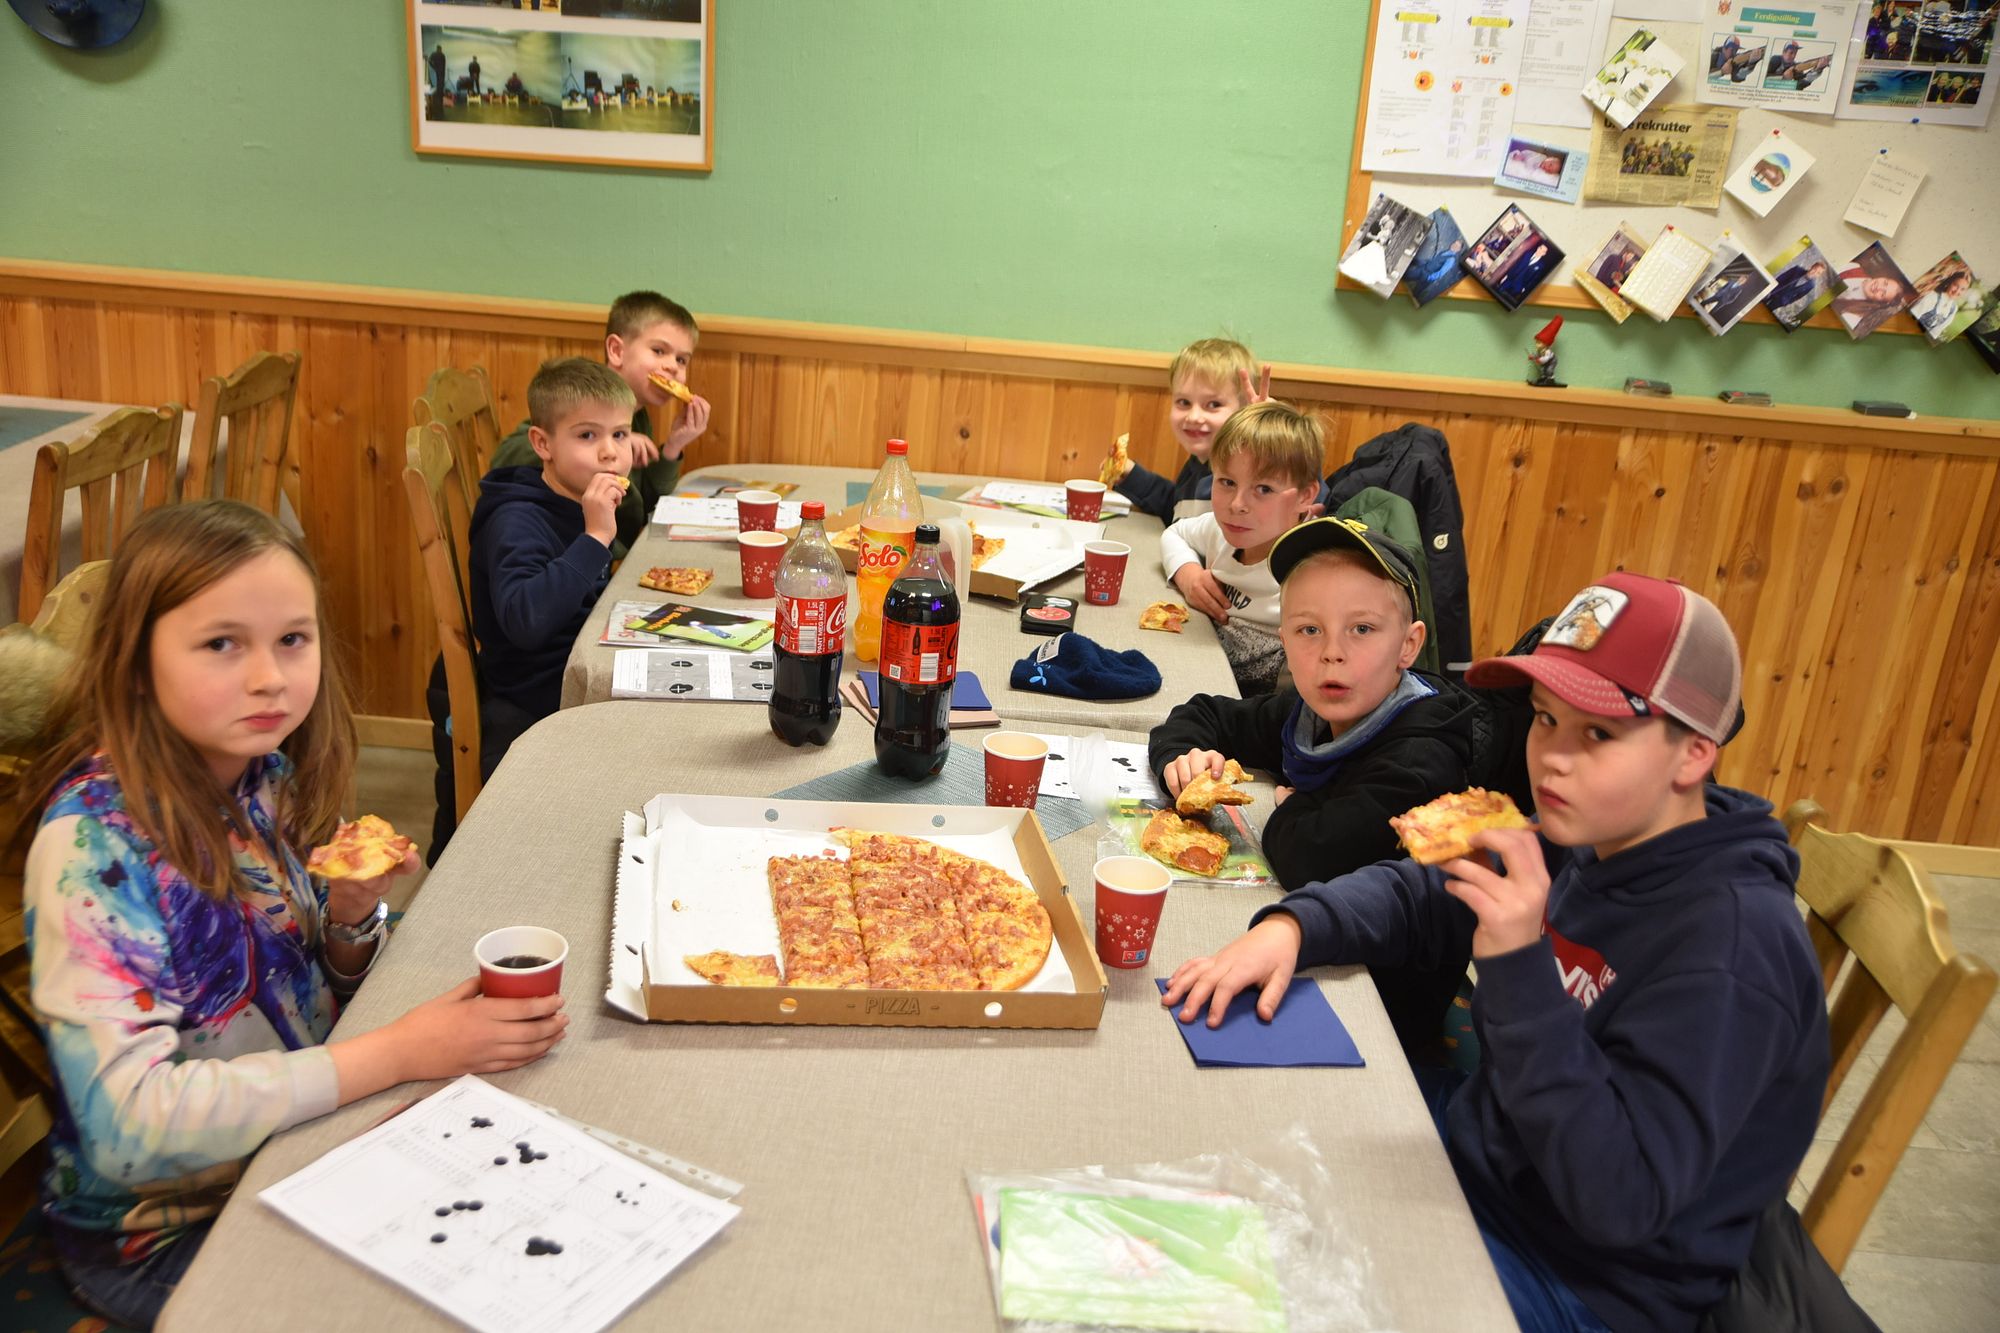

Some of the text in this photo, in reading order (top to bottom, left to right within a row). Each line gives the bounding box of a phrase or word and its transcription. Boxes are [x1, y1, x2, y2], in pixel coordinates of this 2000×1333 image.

[1754, 11, 1801, 24] Ferdigstilling
[1636, 119, 1692, 133] rekrutter
[860, 542, 901, 567] Solo
[865, 996, 921, 1016] PIZZA
